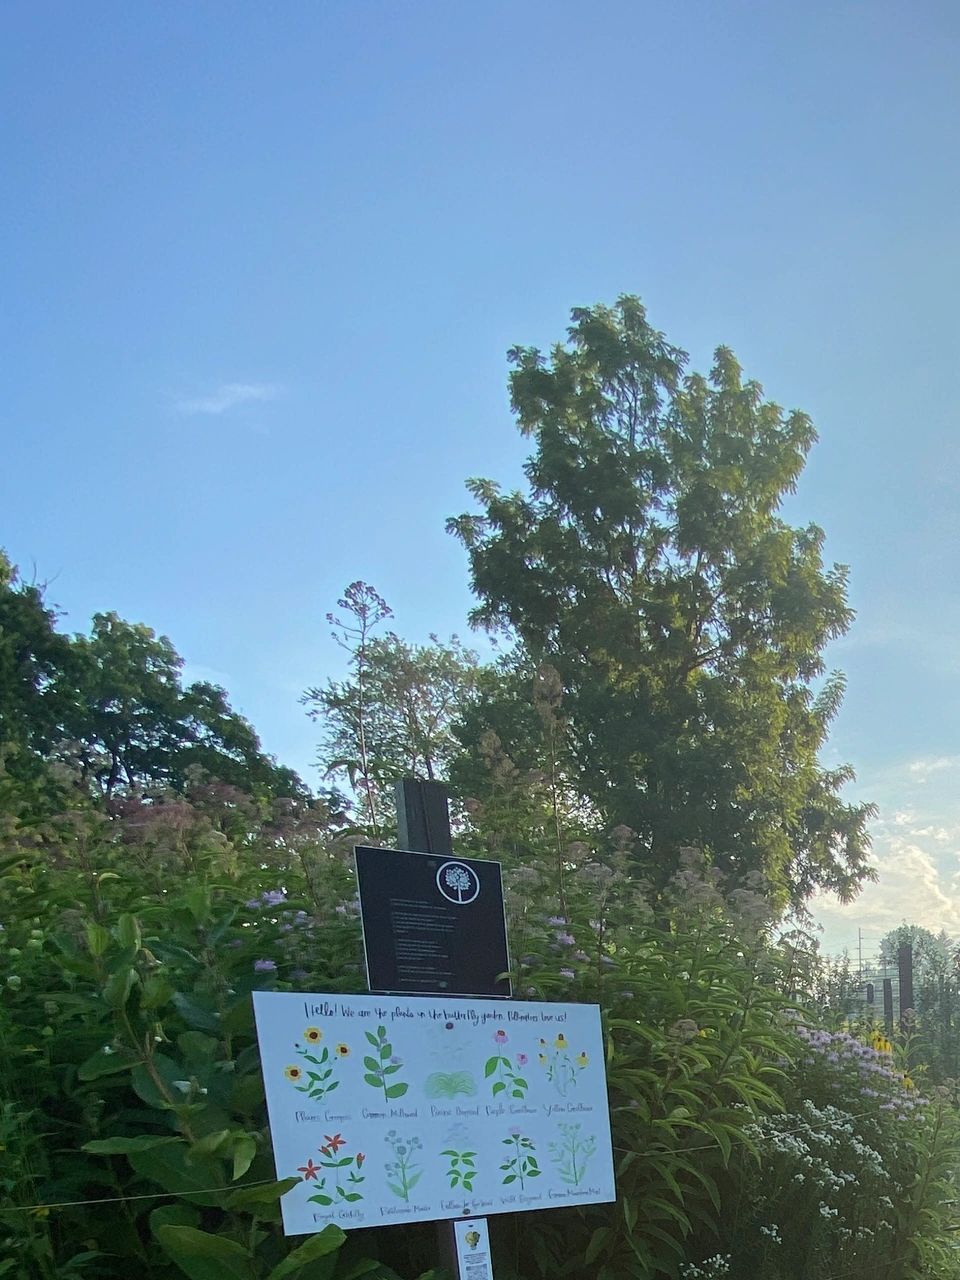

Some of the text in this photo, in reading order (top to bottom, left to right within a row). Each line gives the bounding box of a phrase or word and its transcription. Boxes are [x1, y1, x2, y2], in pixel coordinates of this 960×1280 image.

[304, 1001, 337, 1019] Hello!
[341, 1005, 355, 1018] We
[358, 1010, 371, 1018] are
